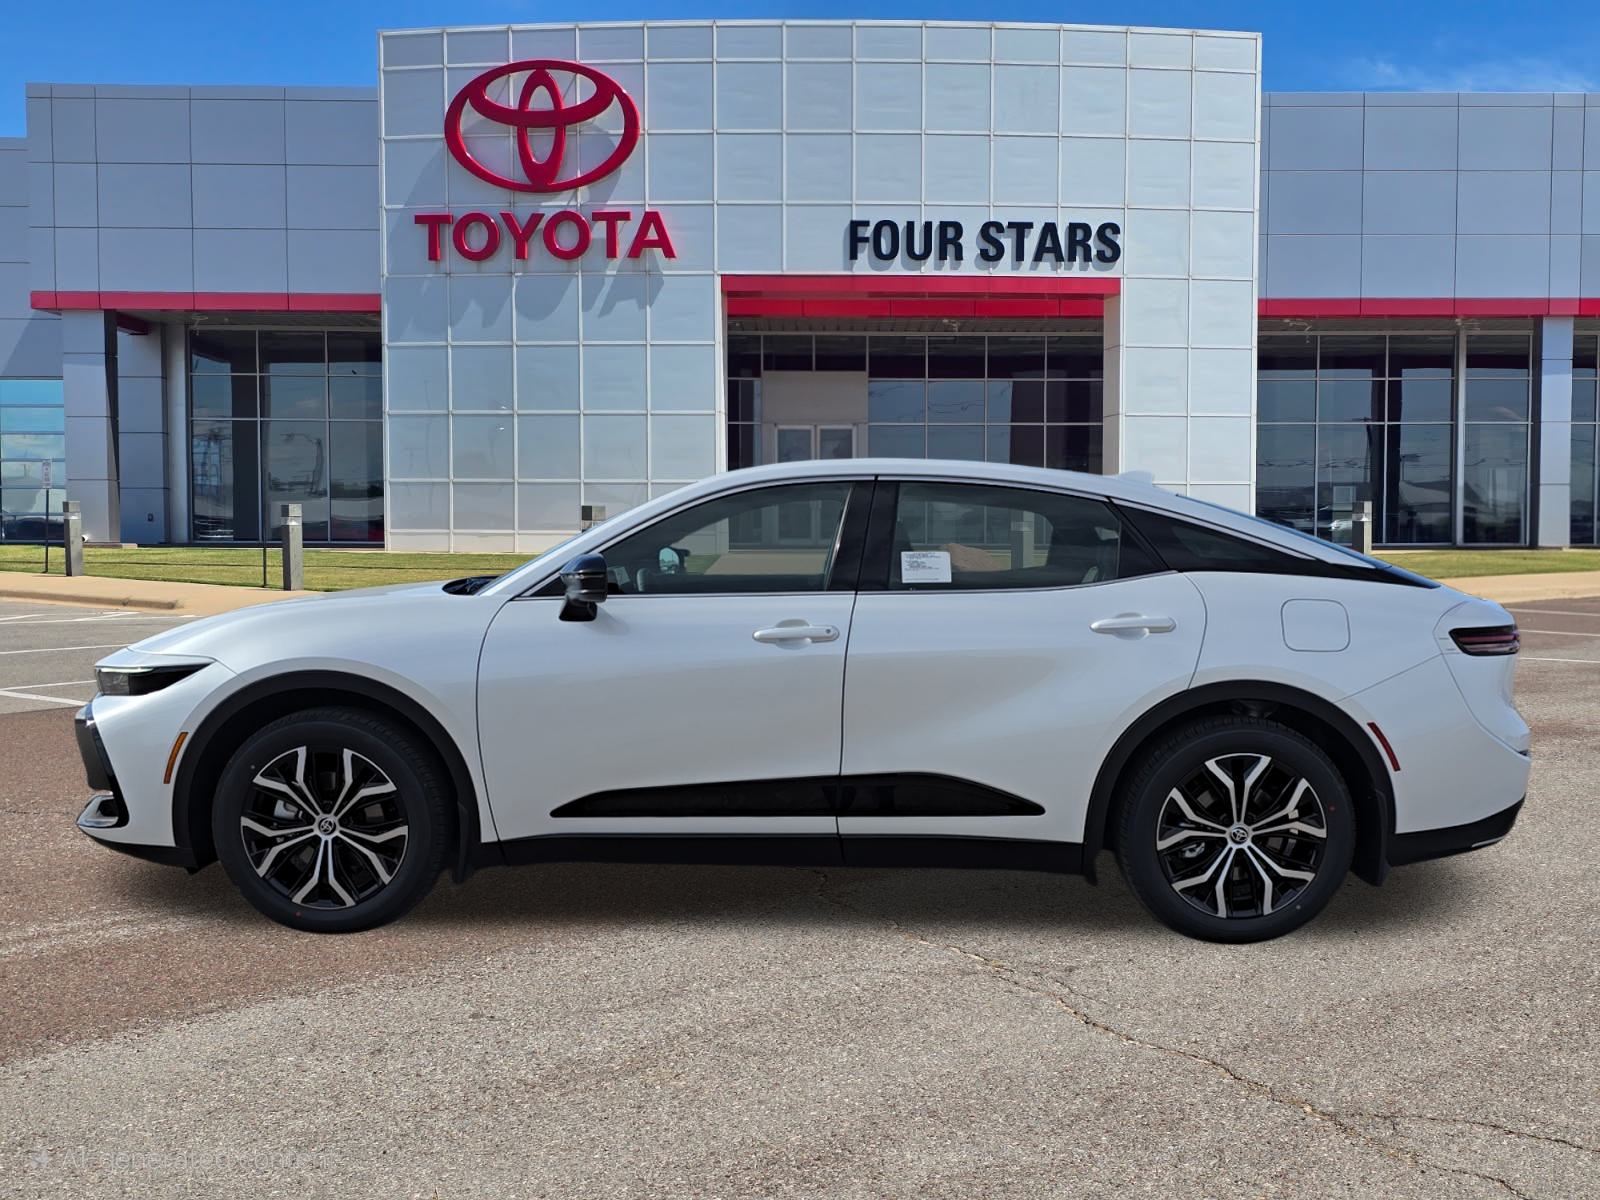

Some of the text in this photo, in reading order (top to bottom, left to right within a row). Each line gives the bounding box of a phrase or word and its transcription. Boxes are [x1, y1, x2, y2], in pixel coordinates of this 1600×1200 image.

[414, 211, 677, 262] TOYOTA
[849, 219, 1122, 263] FOUR STARS
